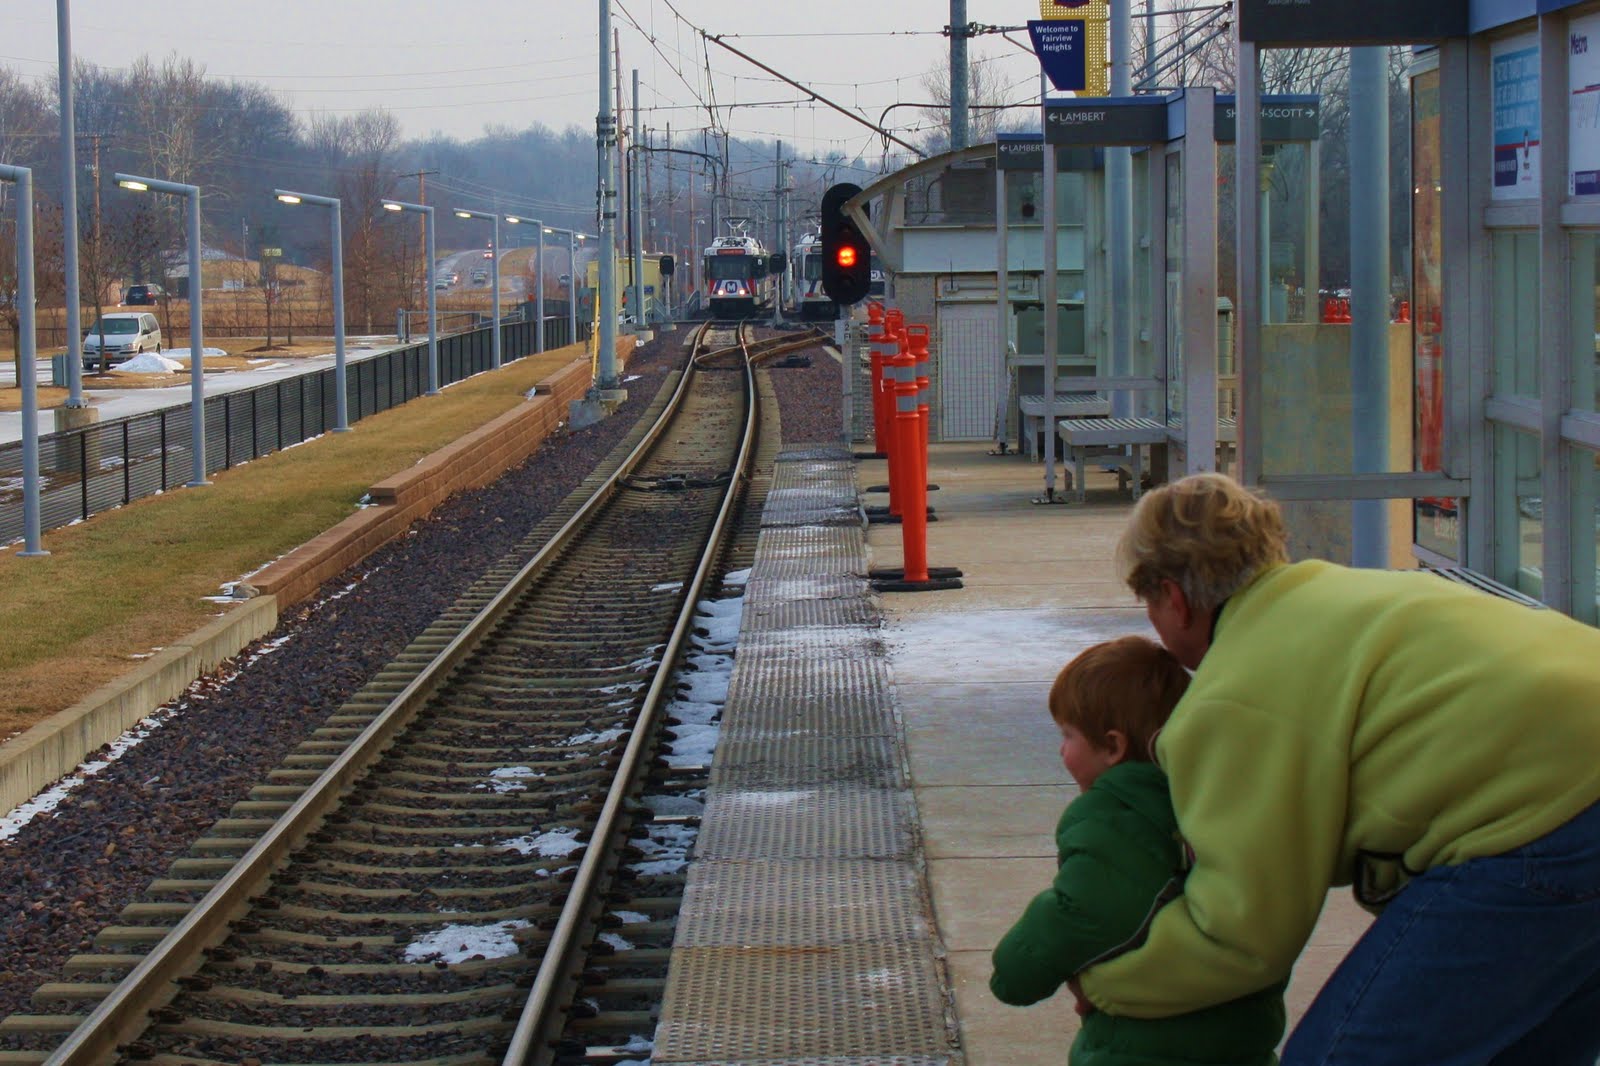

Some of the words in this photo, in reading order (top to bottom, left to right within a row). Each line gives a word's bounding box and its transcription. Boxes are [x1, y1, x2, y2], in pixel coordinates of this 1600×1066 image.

[1035, 25, 1069, 34] Welcome
[1042, 34, 1073, 42] Fairview
[1043, 43, 1072, 52] Heights
[1570, 33, 1588, 55] Metro
[1059, 111, 1106, 122] LAMBERT
[1008, 144, 1044, 152] LAMBERT
